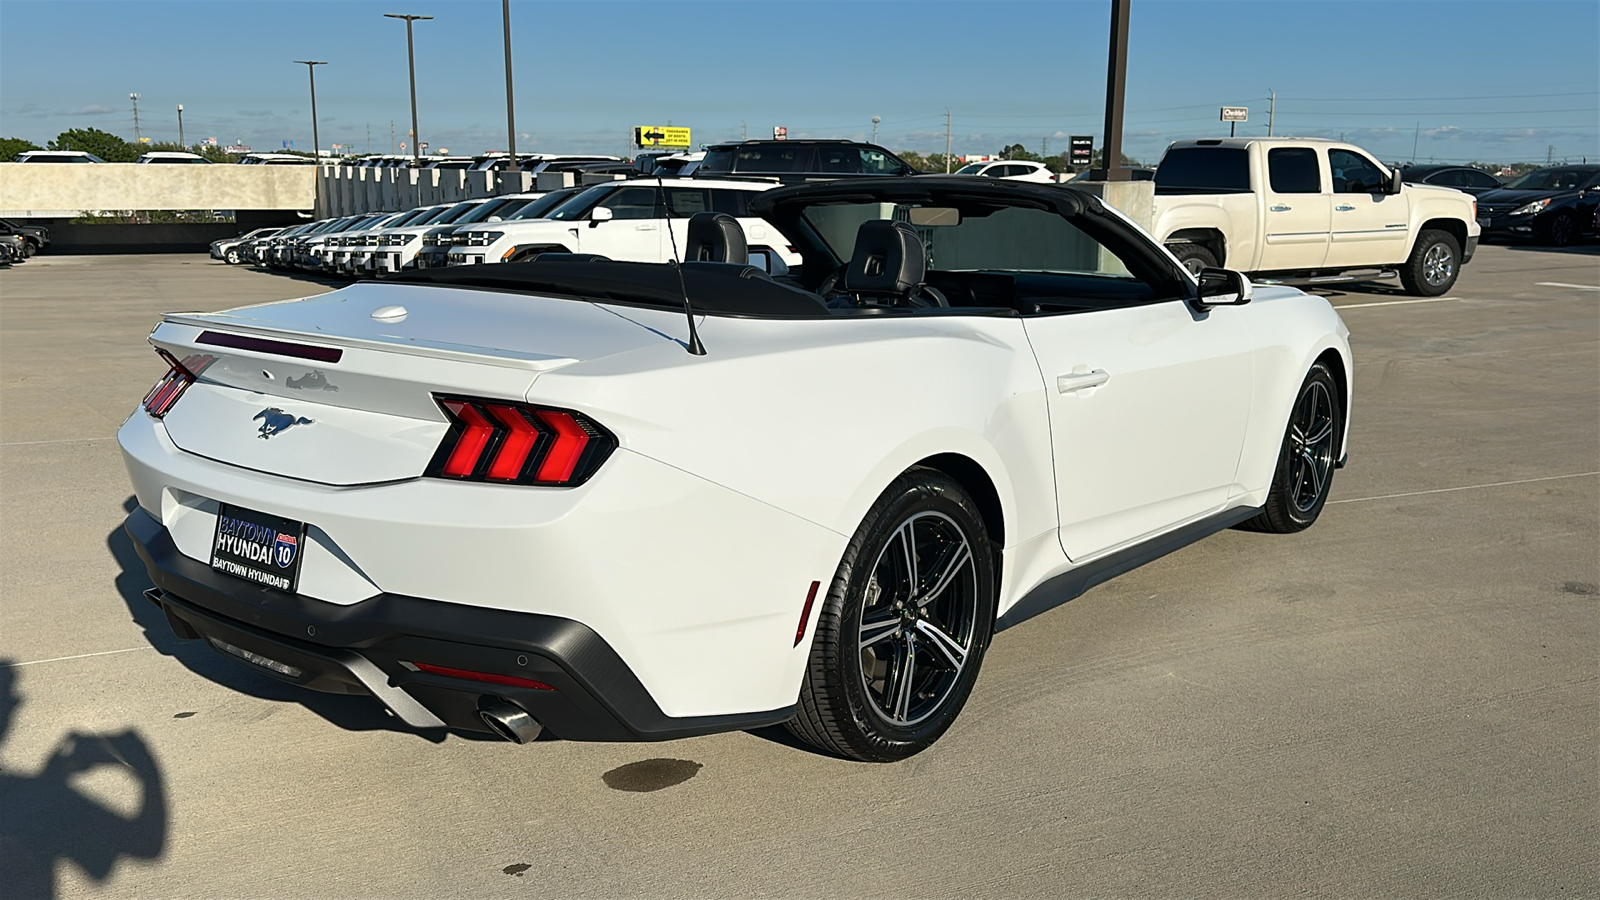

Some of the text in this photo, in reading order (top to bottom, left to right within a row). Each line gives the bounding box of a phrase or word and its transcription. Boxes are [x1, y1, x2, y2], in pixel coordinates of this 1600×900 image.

[220, 516, 277, 547] BAYTOWN
[217, 532, 274, 565] HYUNDAI
[278, 546, 291, 564] 10
[212, 556, 248, 577] BAYTOWN
[247, 568, 283, 589] HYUNDAI
